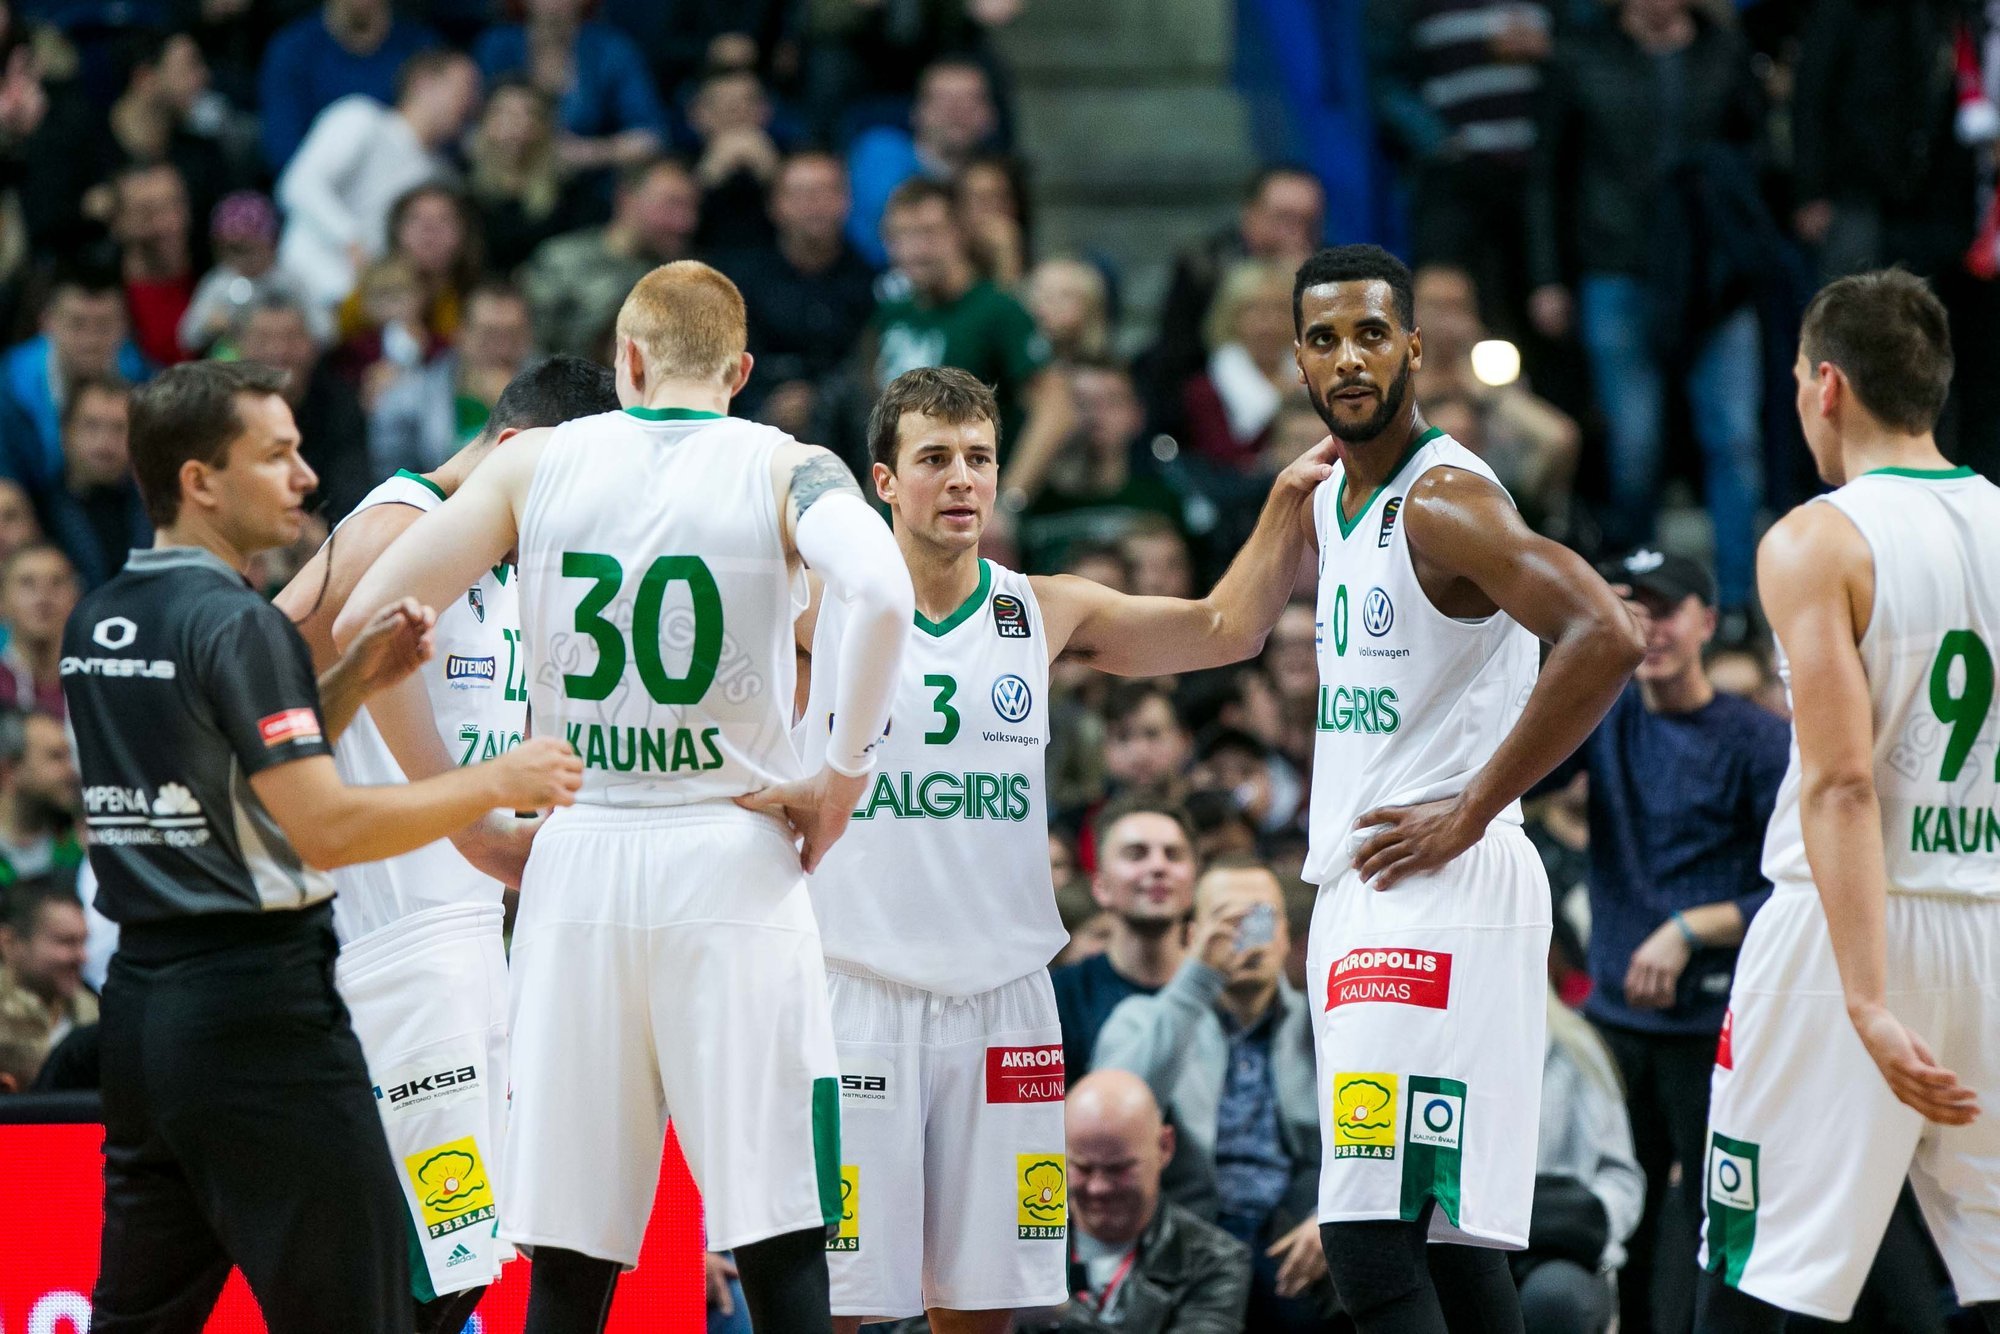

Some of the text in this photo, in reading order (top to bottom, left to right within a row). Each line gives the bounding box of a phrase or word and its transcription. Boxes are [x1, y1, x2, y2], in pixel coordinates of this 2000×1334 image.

[562, 552, 724, 704] 30
[1001, 625, 1026, 636] LKL
[1334, 584, 1348, 657] 0
[1358, 647, 1410, 660] Volkswagen
[450, 658, 494, 677] UTENOS
[923, 674, 961, 745] 3
[1930, 629, 2000, 783] 9
[566, 721, 725, 773] KAUNAS
[982, 730, 1040, 746] Volkswagen
[850, 770, 1031, 823] ALGIRIS
[1334, 951, 1438, 978] AKROPOLIS
[1339, 982, 1412, 1002] KAUNAS
[387, 1065, 476, 1103] aksa
[1018, 1081, 1065, 1099] KAUN
[1335, 1145, 1393, 1158] PERLAS
[429, 1205, 496, 1238] PERLAS
[1019, 1226, 1065, 1238] PERLAS
[446, 1253, 477, 1268] adidas
